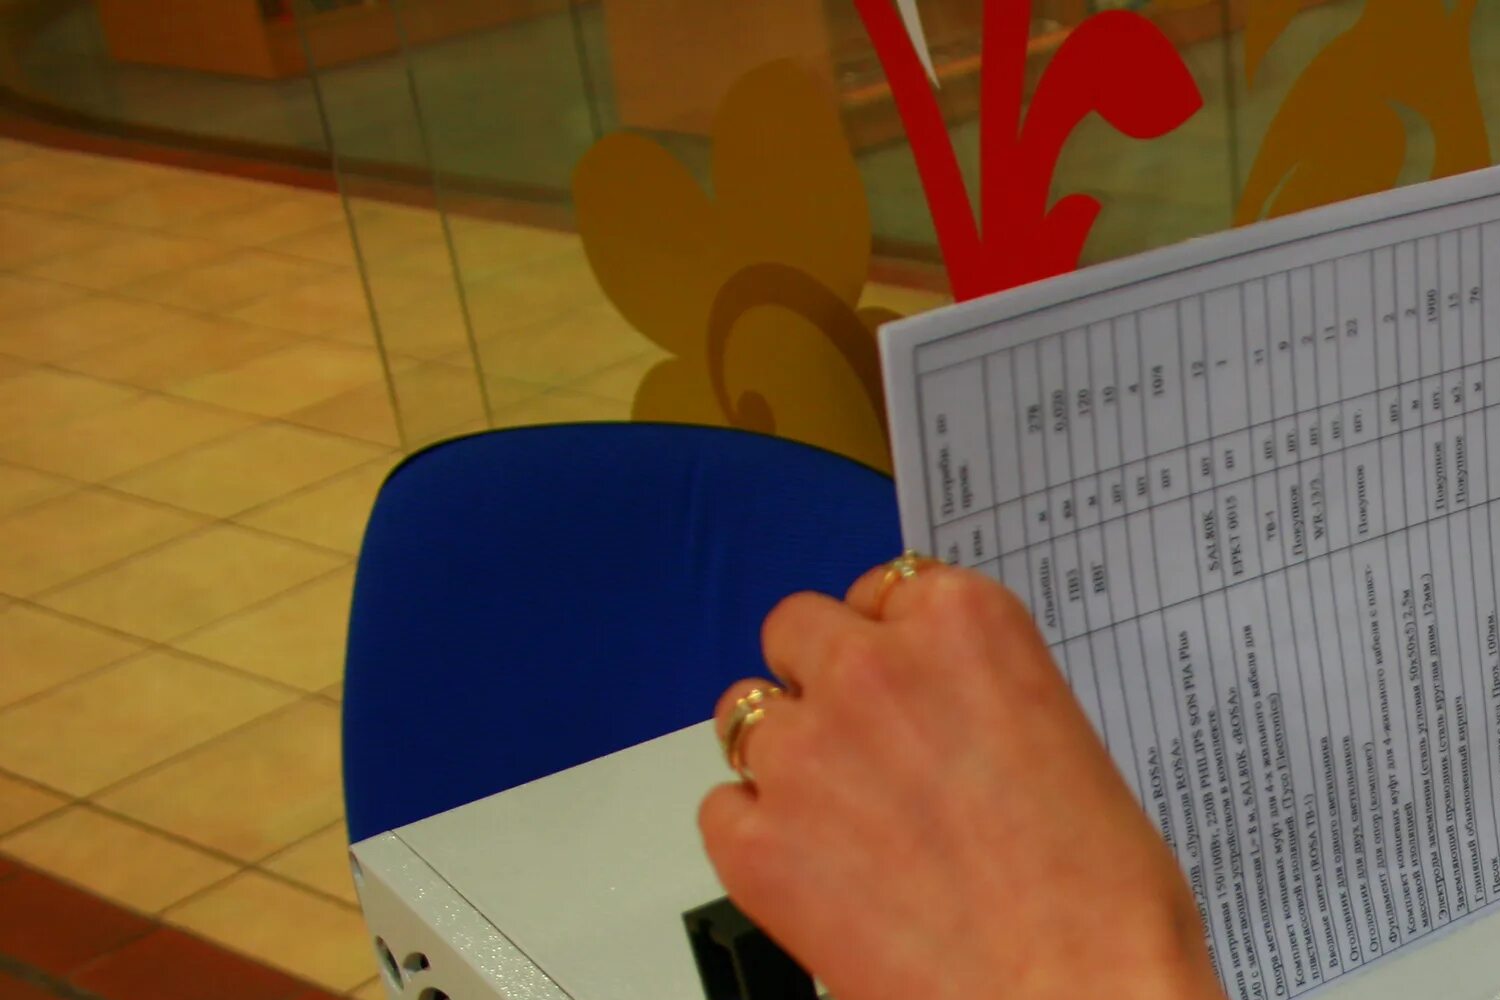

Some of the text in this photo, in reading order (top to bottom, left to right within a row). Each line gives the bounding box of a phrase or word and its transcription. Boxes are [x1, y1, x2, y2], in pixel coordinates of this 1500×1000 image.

[1356, 464, 1369, 535] Покупное
[1177, 631, 1190, 661] Plus
[1242, 625, 1256, 648] для
[1370, 620, 1384, 665] кабеля
[1181, 664, 1196, 690] PIA
[1245, 652, 1261, 698] кабеля
[1429, 660, 1447, 710] круглая
[1185, 693, 1199, 726] SON
[1253, 701, 1272, 768] жильного
[1374, 669, 1393, 745] 4-жильного
[1412, 685, 1428, 734] угловая
[1193, 728, 1211, 788] PHILIPS
[1385, 749, 1396, 770] для
[1416, 737, 1430, 775] (сталь
[1200, 792, 1218, 826] 220В
[1220, 786, 1229, 794] в
[1385, 774, 1401, 805] муфт
[1420, 779, 1437, 848] заземления
[1440, 756, 1455, 821] проводник
[1454, 696, 1485, 903] Глиняный обыкновенный кирпич
[1220, 798, 1244, 879] устройством
[1266, 692, 1320, 980] пластмассовой изоляцией (Tyco Electronics)
[1273, 822, 1289, 854] муфт
[1307, 829, 1323, 871] (ROSA
[1320, 736, 1360, 961] Оголовник для одного светильника
[1341, 736, 1380, 952] Оголовник для двух светильников
[1362, 742, 1400, 943] Фундамент для опор (комплект)
[1392, 809, 1409, 869] концевых
[1404, 801, 1430, 928] массовой изоляцией
[1274, 857, 1294, 920] концевых
[1313, 874, 1328, 912] щитки
[1431, 851, 1448, 920] Электроды
[1446, 825, 1466, 911] Заземляющий
[1233, 882, 1257, 967] зажигающим
[1253, 857, 1275, 952] металлическая
[1400, 872, 1417, 935] Комплект
[1221, 902, 1242, 967] натриевая
[1286, 923, 1307, 987] Комплект
[1322, 916, 1338, 968] Вводные
[1270, 955, 1286, 997] Опора
